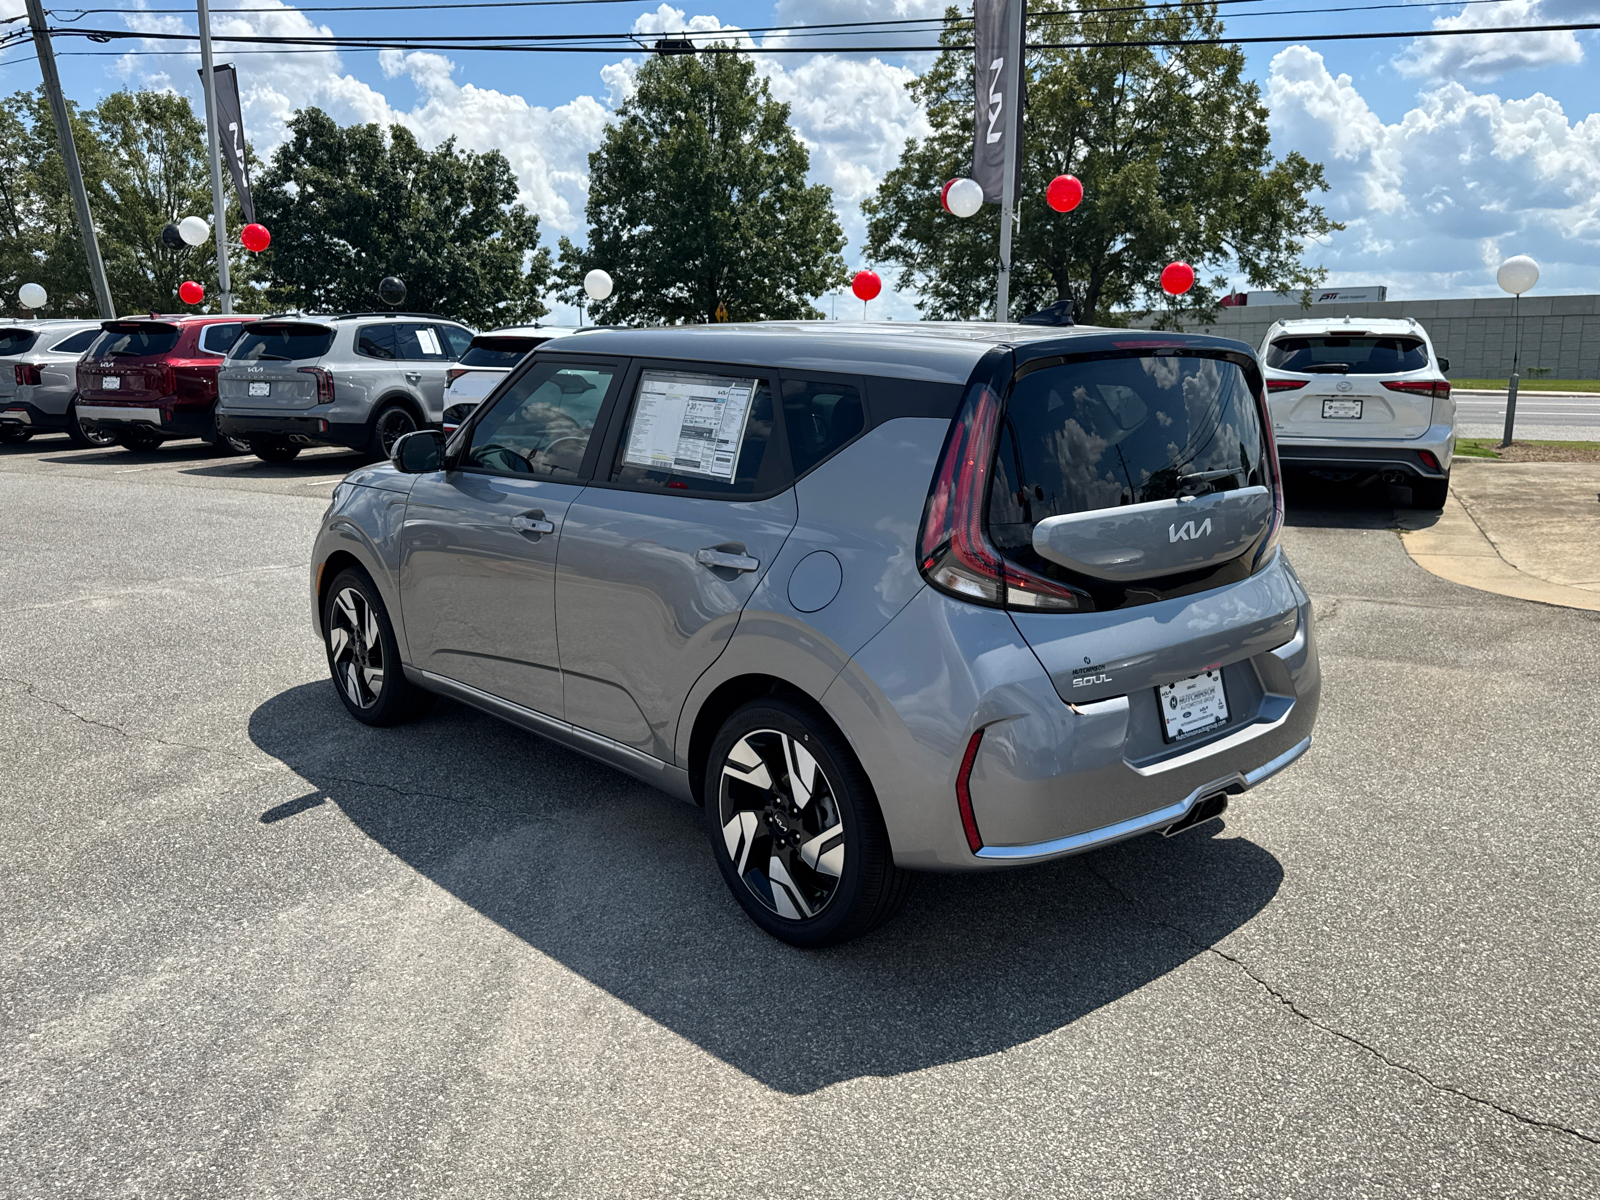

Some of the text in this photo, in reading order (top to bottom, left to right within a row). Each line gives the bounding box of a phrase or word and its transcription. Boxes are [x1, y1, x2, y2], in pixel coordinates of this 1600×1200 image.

[1168, 517, 1212, 543] KIA
[1072, 664, 1106, 675] HUTCHINSON
[1072, 674, 1113, 688] SOUL
[1179, 685, 1216, 706] HUTCHINSON
